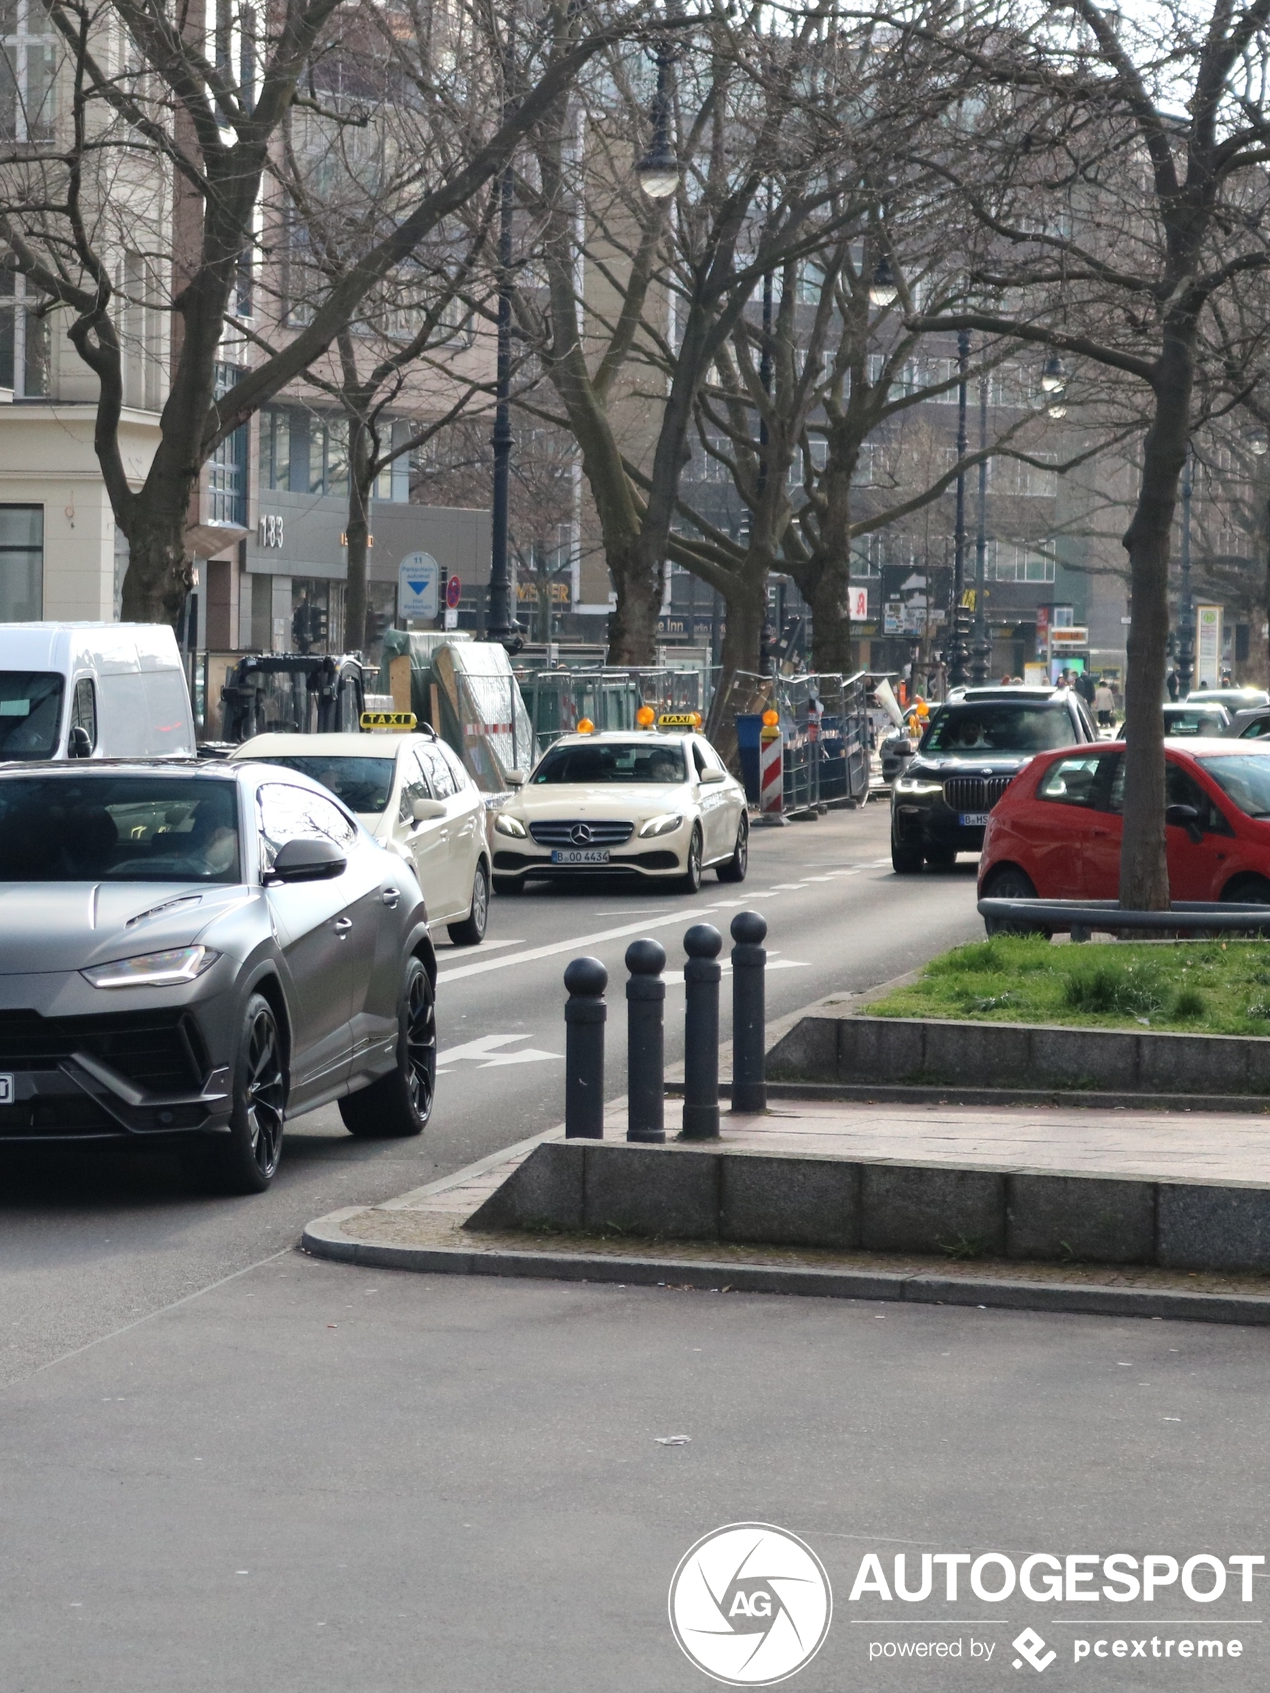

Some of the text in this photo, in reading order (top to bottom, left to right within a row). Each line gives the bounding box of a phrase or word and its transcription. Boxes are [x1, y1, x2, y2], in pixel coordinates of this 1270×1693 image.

[260, 515, 284, 548] 183
[369, 715, 405, 724] TAXI
[965, 815, 971, 825] B
[558, 852, 563, 861] B
[585, 852, 608, 861] 4434
